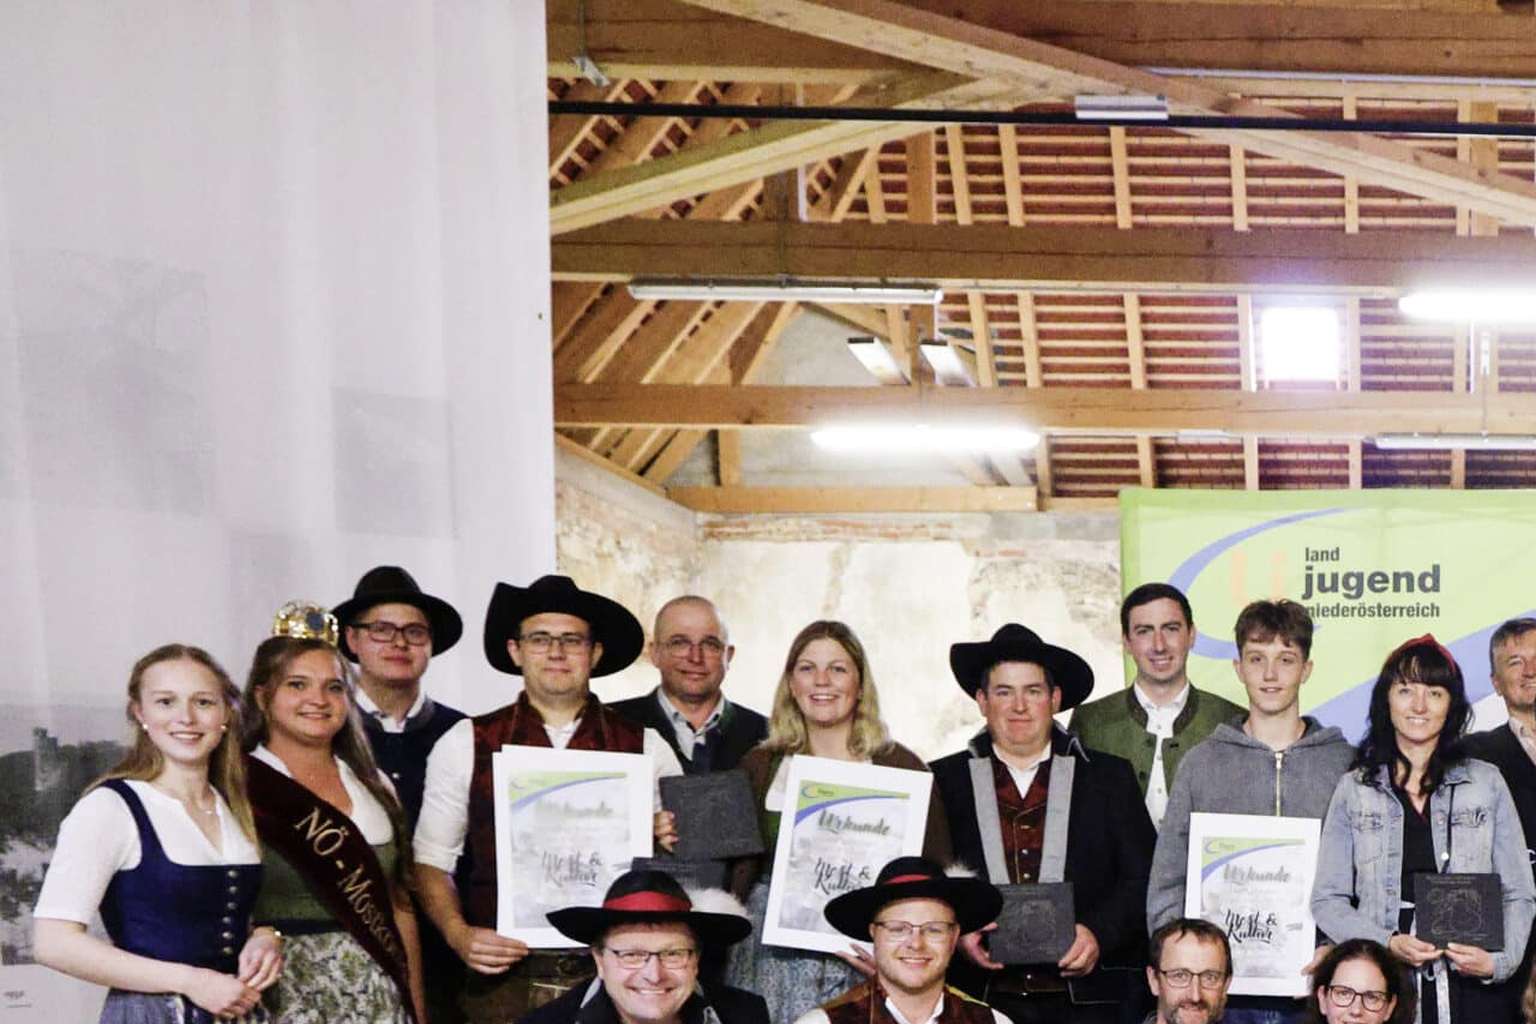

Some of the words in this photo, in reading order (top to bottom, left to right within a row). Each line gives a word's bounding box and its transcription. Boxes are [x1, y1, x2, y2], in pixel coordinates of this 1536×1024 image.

[1304, 547, 1340, 562] land
[1302, 564, 1441, 600] jugend
[1305, 602, 1441, 618] niederösterreich
[818, 809, 891, 835] Urkunde
[293, 807, 350, 856] NÖ
[858, 865, 871, 880] &
[1266, 913, 1278, 926] &
